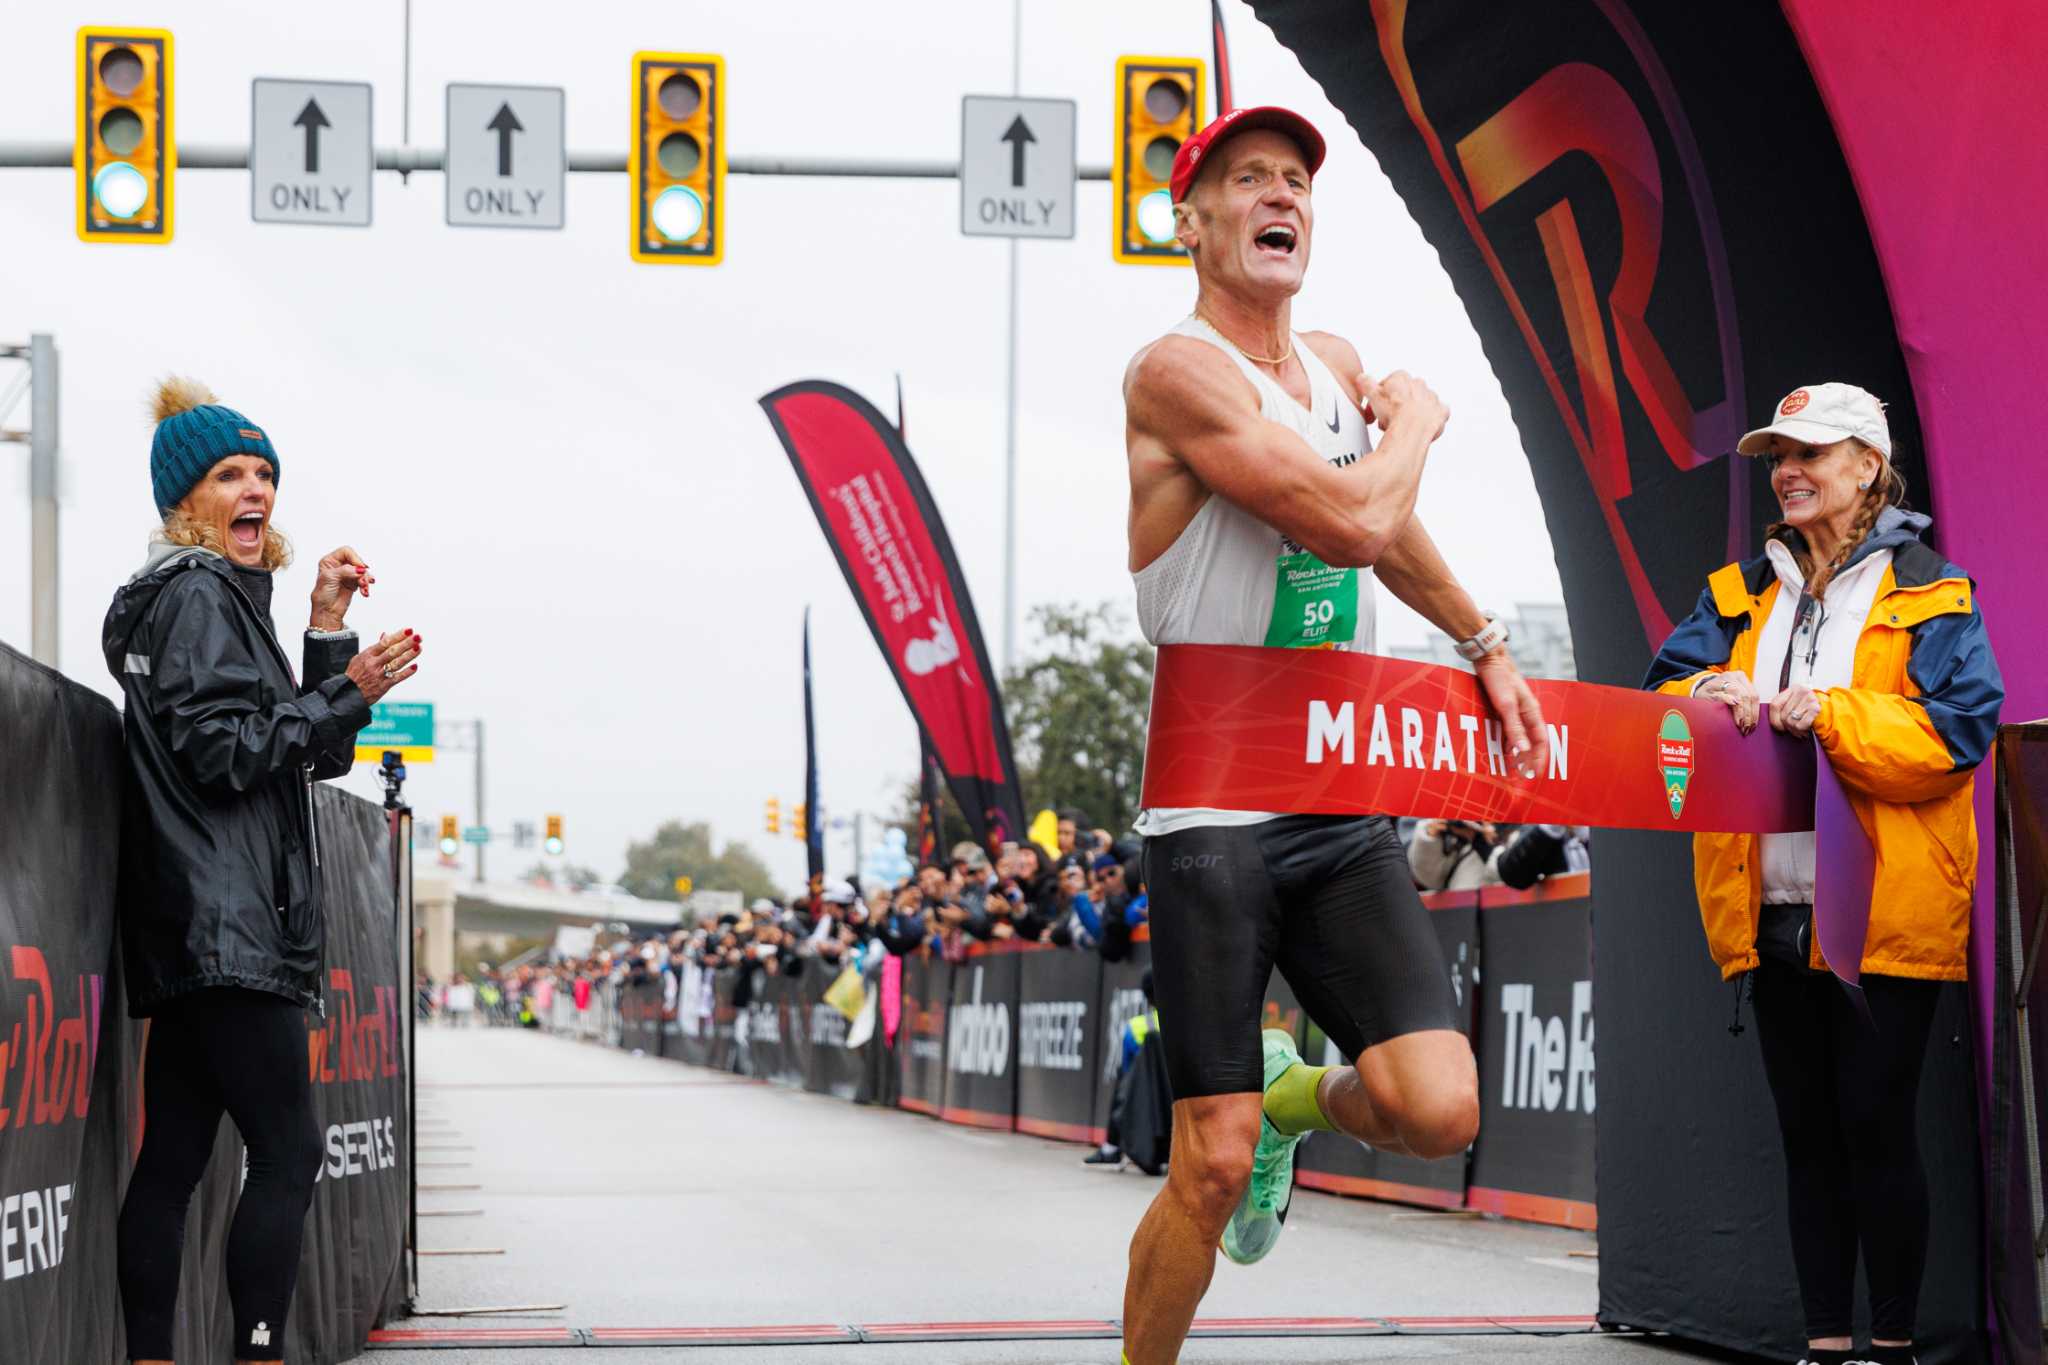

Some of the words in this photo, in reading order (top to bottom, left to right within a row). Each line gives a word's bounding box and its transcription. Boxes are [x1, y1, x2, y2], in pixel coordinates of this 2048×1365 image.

[269, 184, 352, 214] ONLY
[464, 187, 545, 215] ONLY
[978, 198, 1057, 226] ONLY
[851, 474, 892, 545] Hospital
[884, 540, 923, 614] Research
[1303, 599, 1335, 626] 50
[1302, 624, 1330, 638] ELITE
[1305, 700, 1569, 781] MARATHN
[1170, 854, 1224, 872] soar
[326, 1115, 395, 1180] SERIES
[0, 1183, 76, 1281] ERIE
